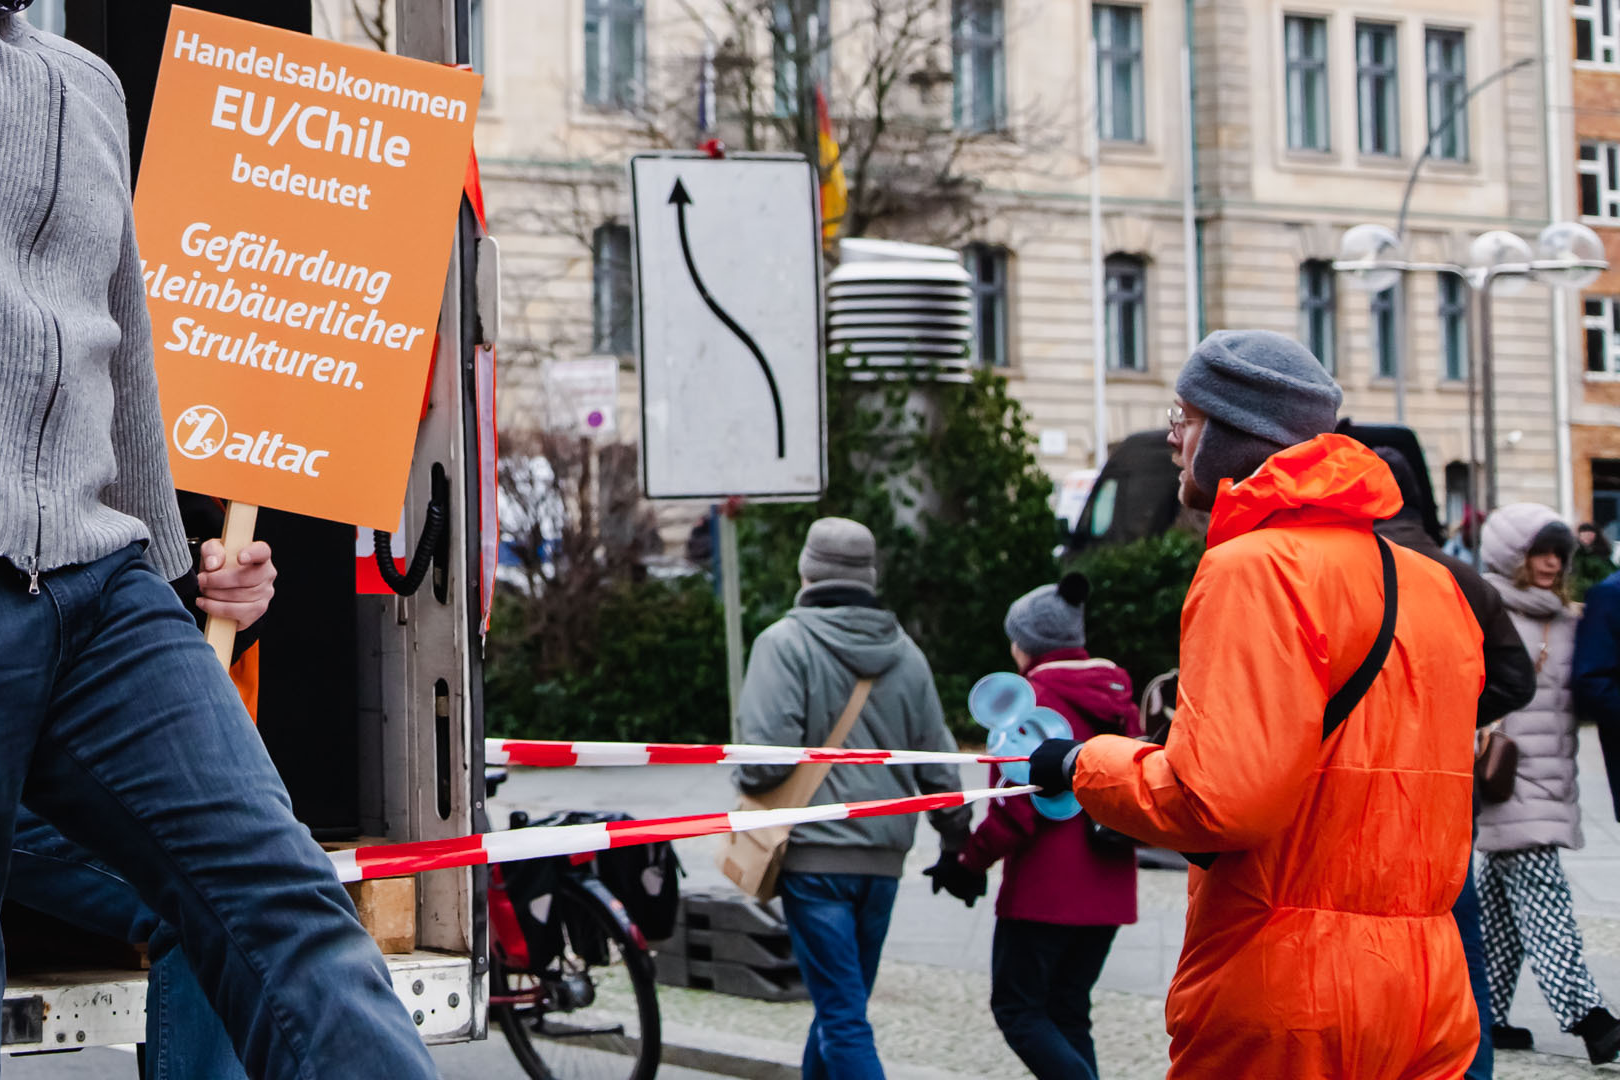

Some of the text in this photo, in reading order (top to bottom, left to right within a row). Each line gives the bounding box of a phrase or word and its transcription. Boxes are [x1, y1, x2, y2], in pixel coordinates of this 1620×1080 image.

[173, 31, 468, 123] Handelsabkommen
[211, 86, 411, 168] EU/Chile
[231, 153, 371, 211] bedeutet
[181, 222, 392, 304] Gefährdung
[164, 316, 365, 390] Strukturen.
[224, 429, 330, 478] attac
